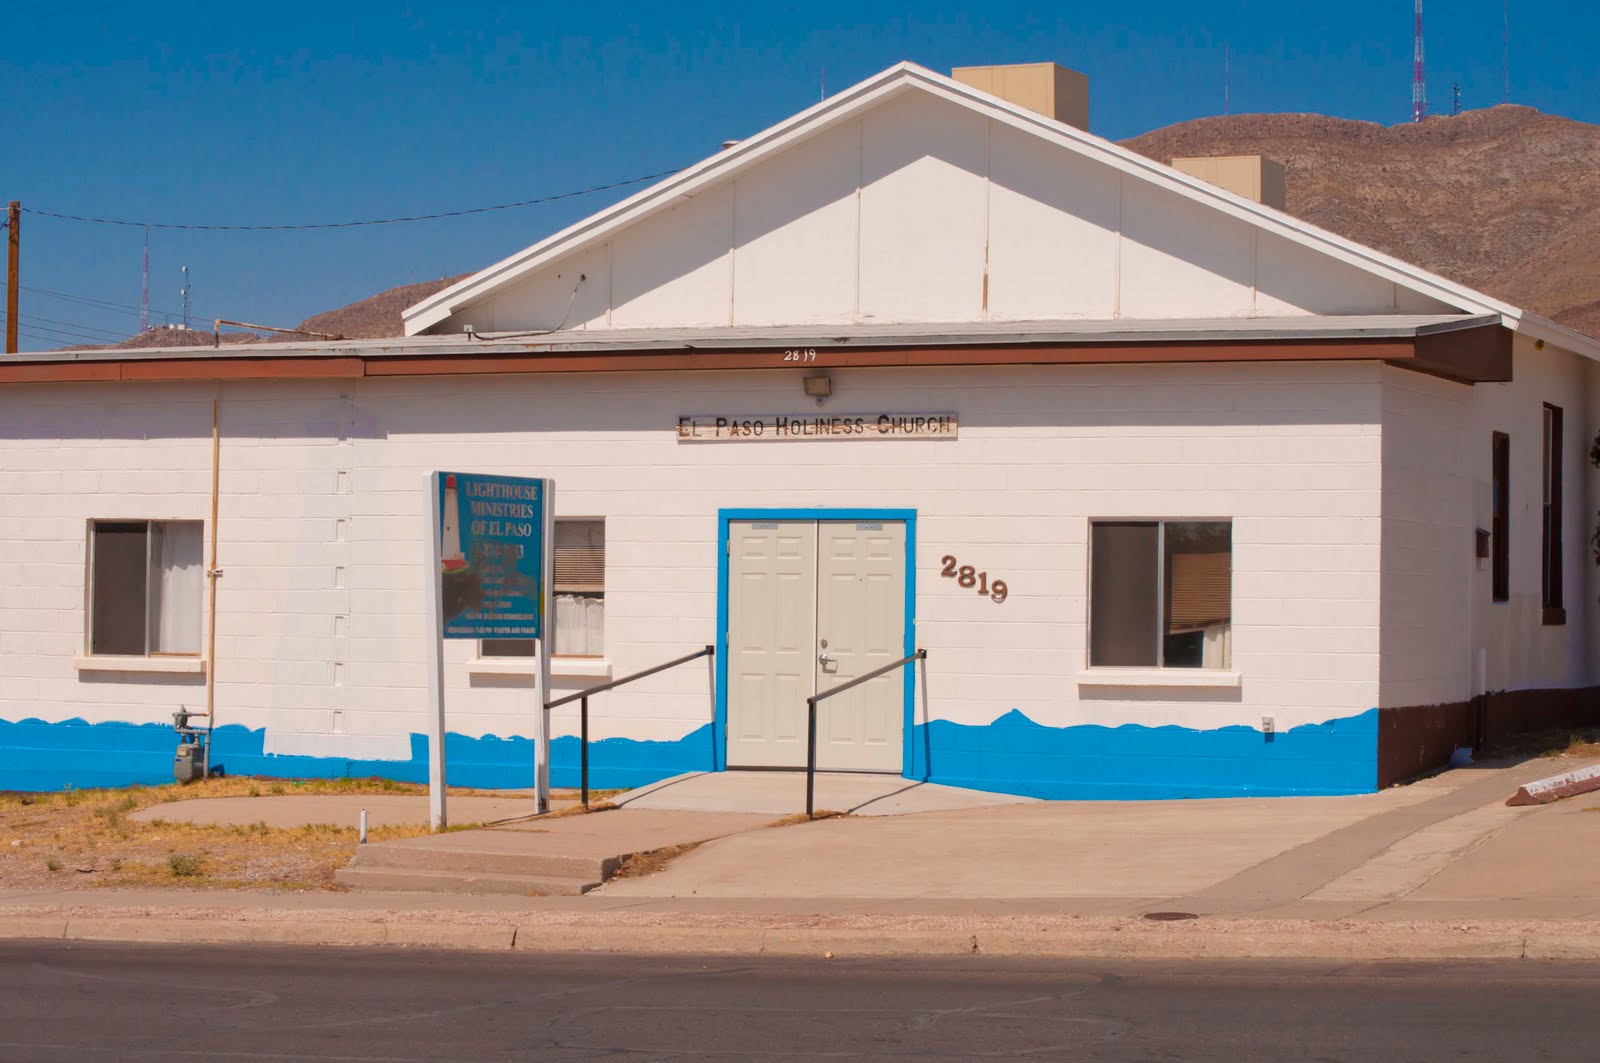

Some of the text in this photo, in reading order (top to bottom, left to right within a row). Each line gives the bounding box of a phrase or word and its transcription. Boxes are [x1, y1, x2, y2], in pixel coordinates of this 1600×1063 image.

[679, 414, 950, 437] EL PASO HOLINESS CHURCH
[466, 481, 537, 500] LIGHTHOUSE
[471, 501, 533, 519] MINISTRIES
[471, 520, 532, 537] OF EL PASO
[941, 555, 1008, 604] 2819
